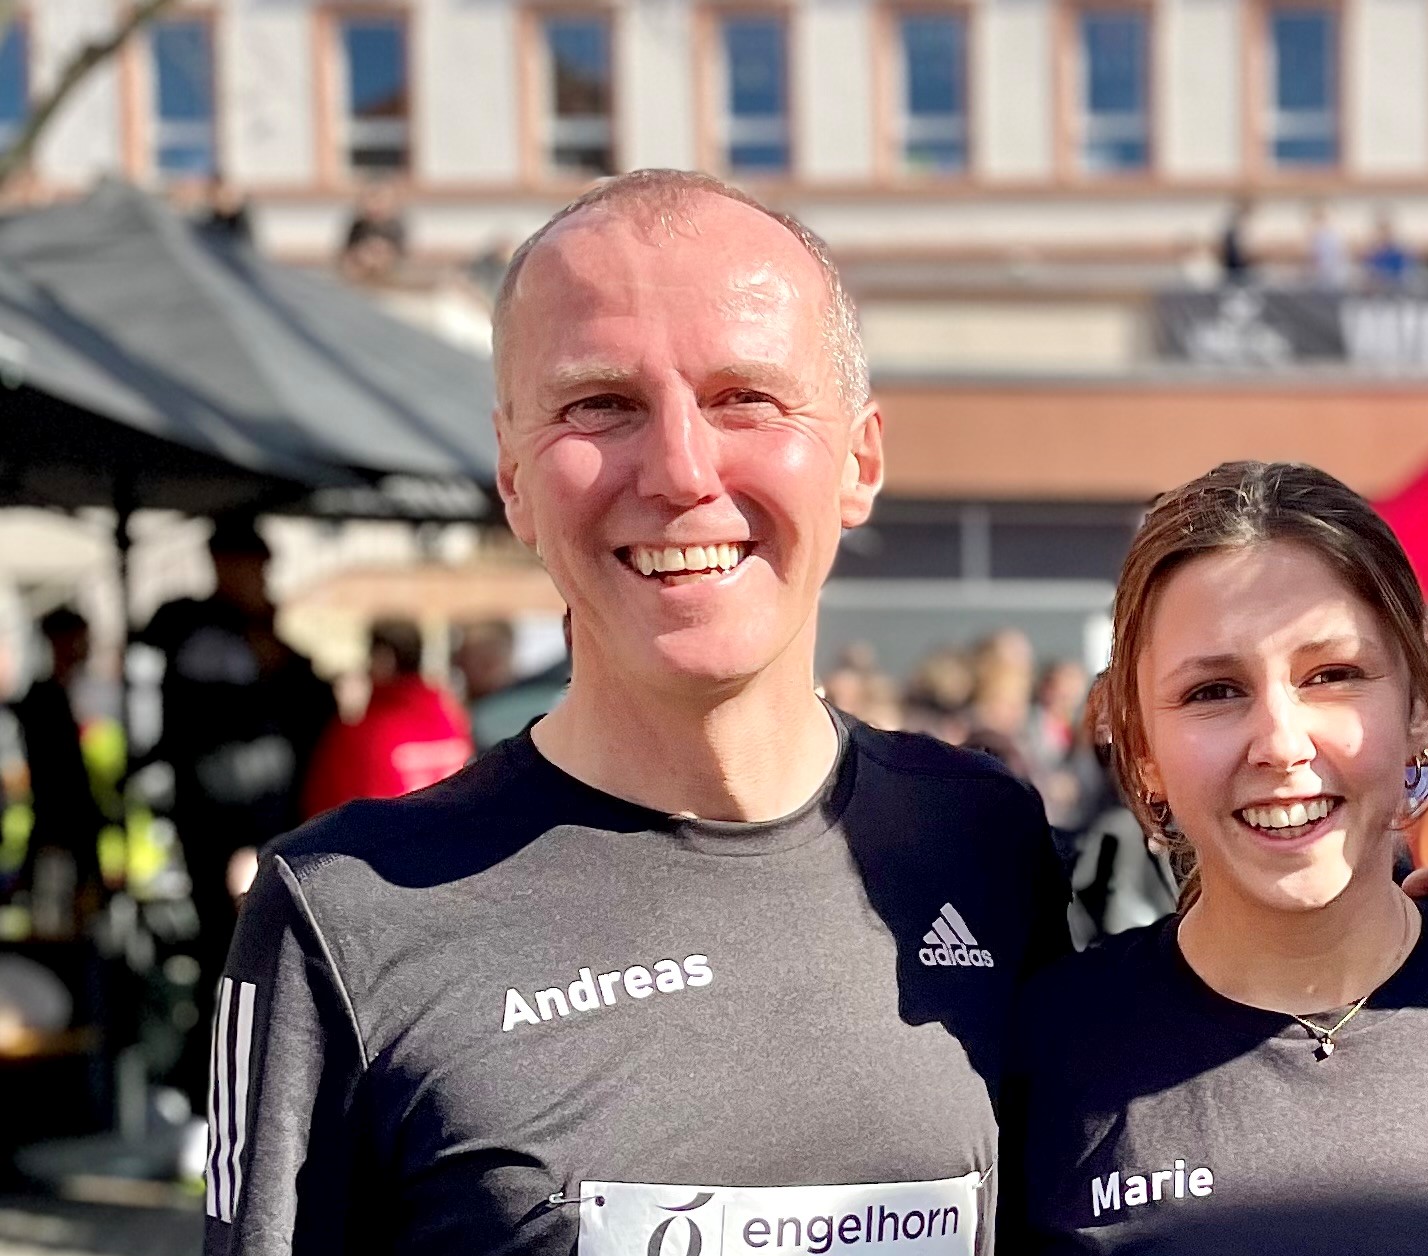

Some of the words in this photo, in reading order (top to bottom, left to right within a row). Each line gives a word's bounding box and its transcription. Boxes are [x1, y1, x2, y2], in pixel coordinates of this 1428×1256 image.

[918, 943, 995, 968] adidas
[502, 953, 714, 1032] Andreas
[1091, 1159, 1214, 1217] Marie
[742, 1204, 960, 1255] engelhorn
